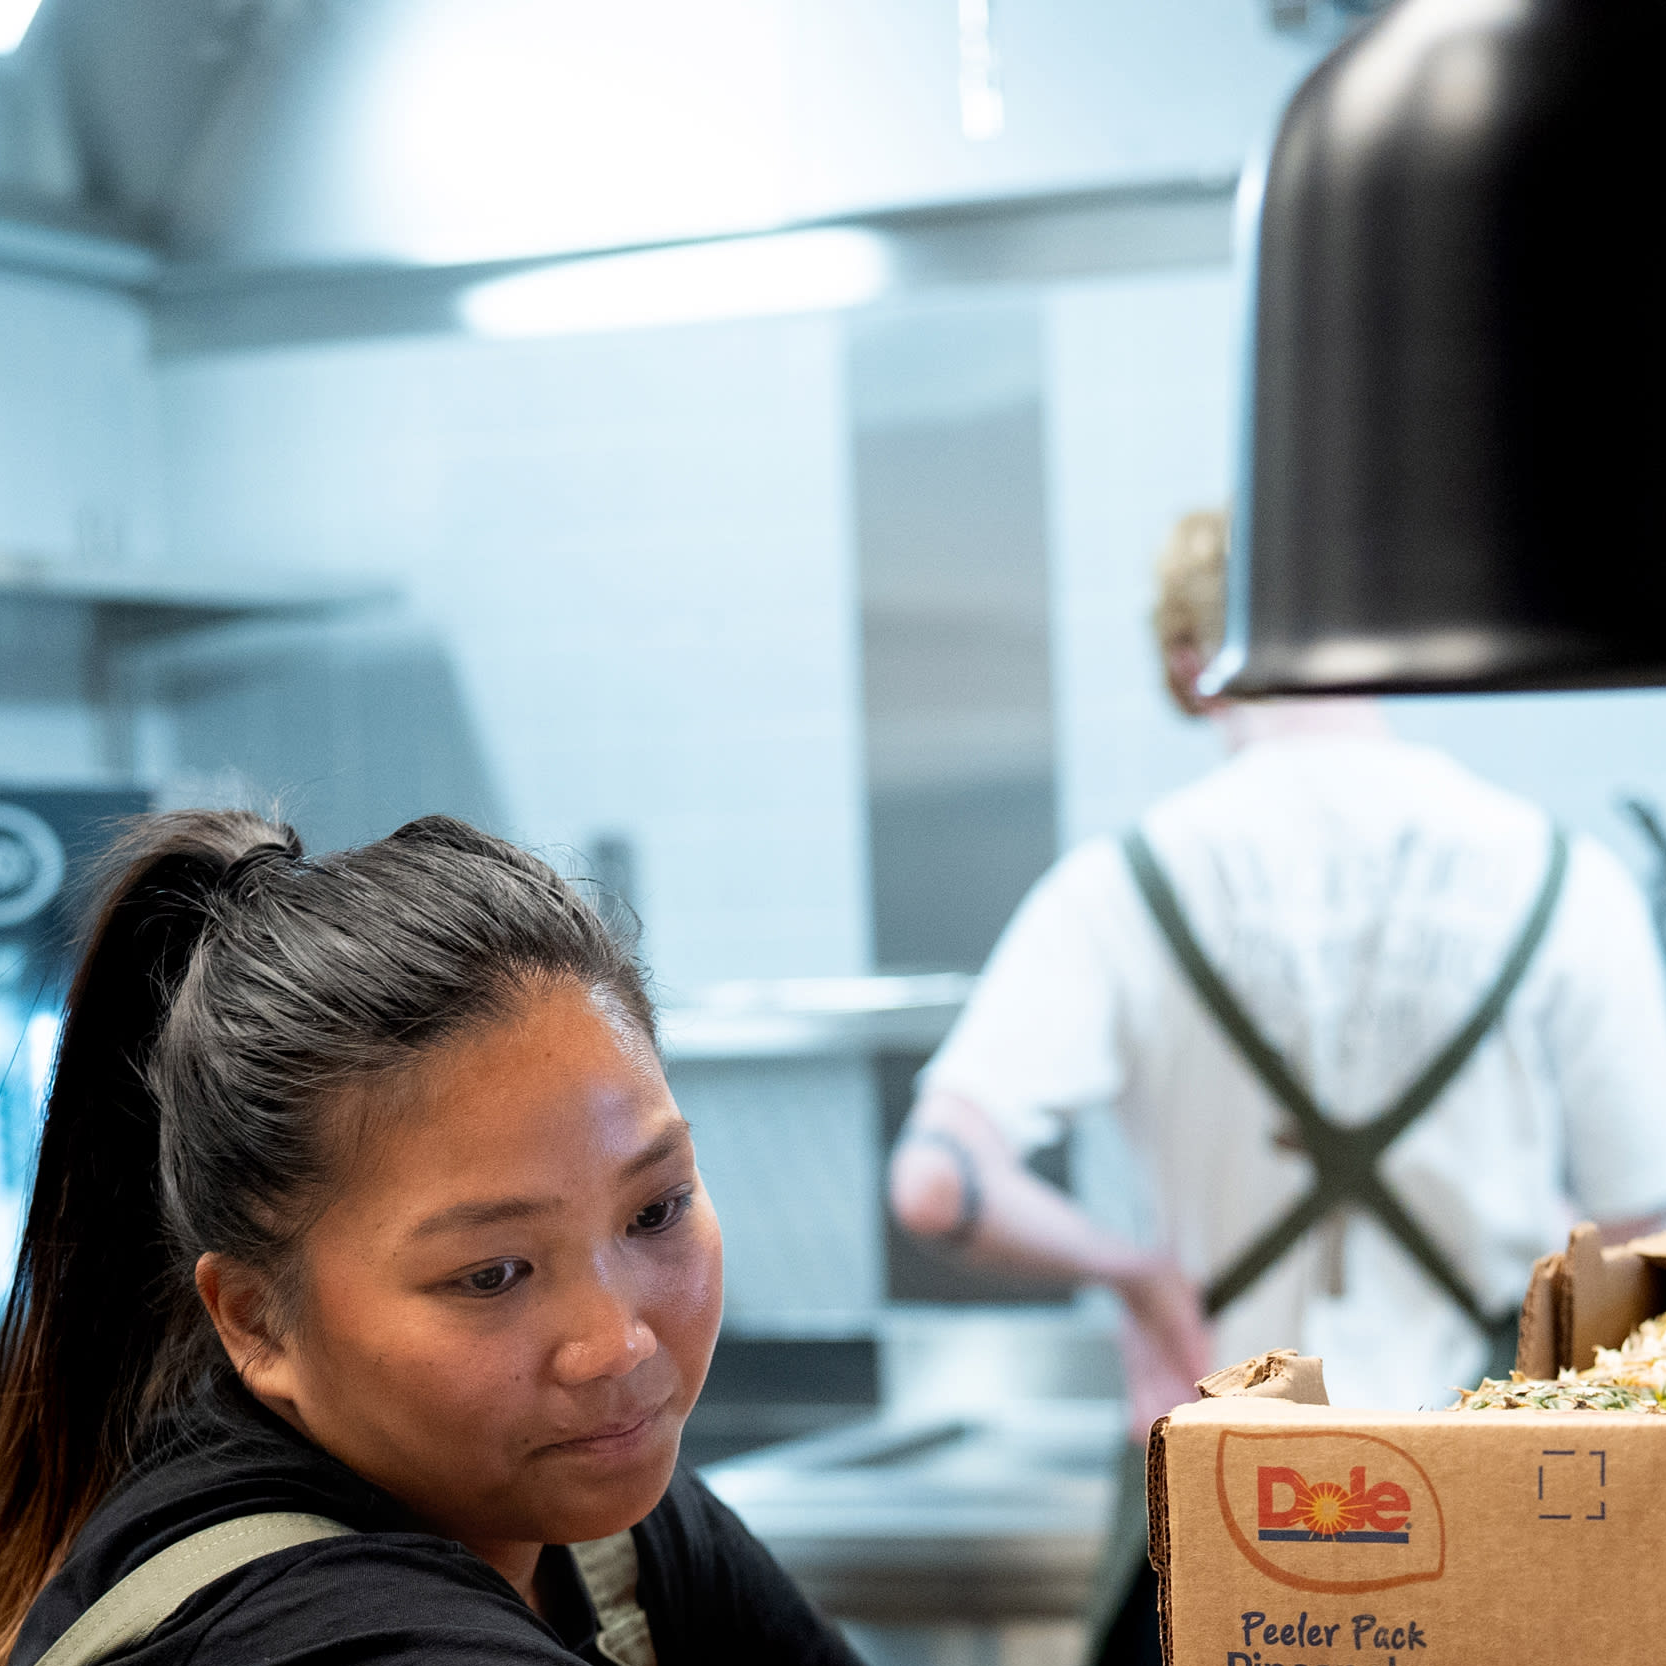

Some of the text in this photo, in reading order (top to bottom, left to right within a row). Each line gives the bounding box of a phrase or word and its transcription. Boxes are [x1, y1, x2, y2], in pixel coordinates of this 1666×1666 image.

[1257, 1465, 1412, 1535] Dole
[1241, 1611, 1427, 1651] Peeler Pack
